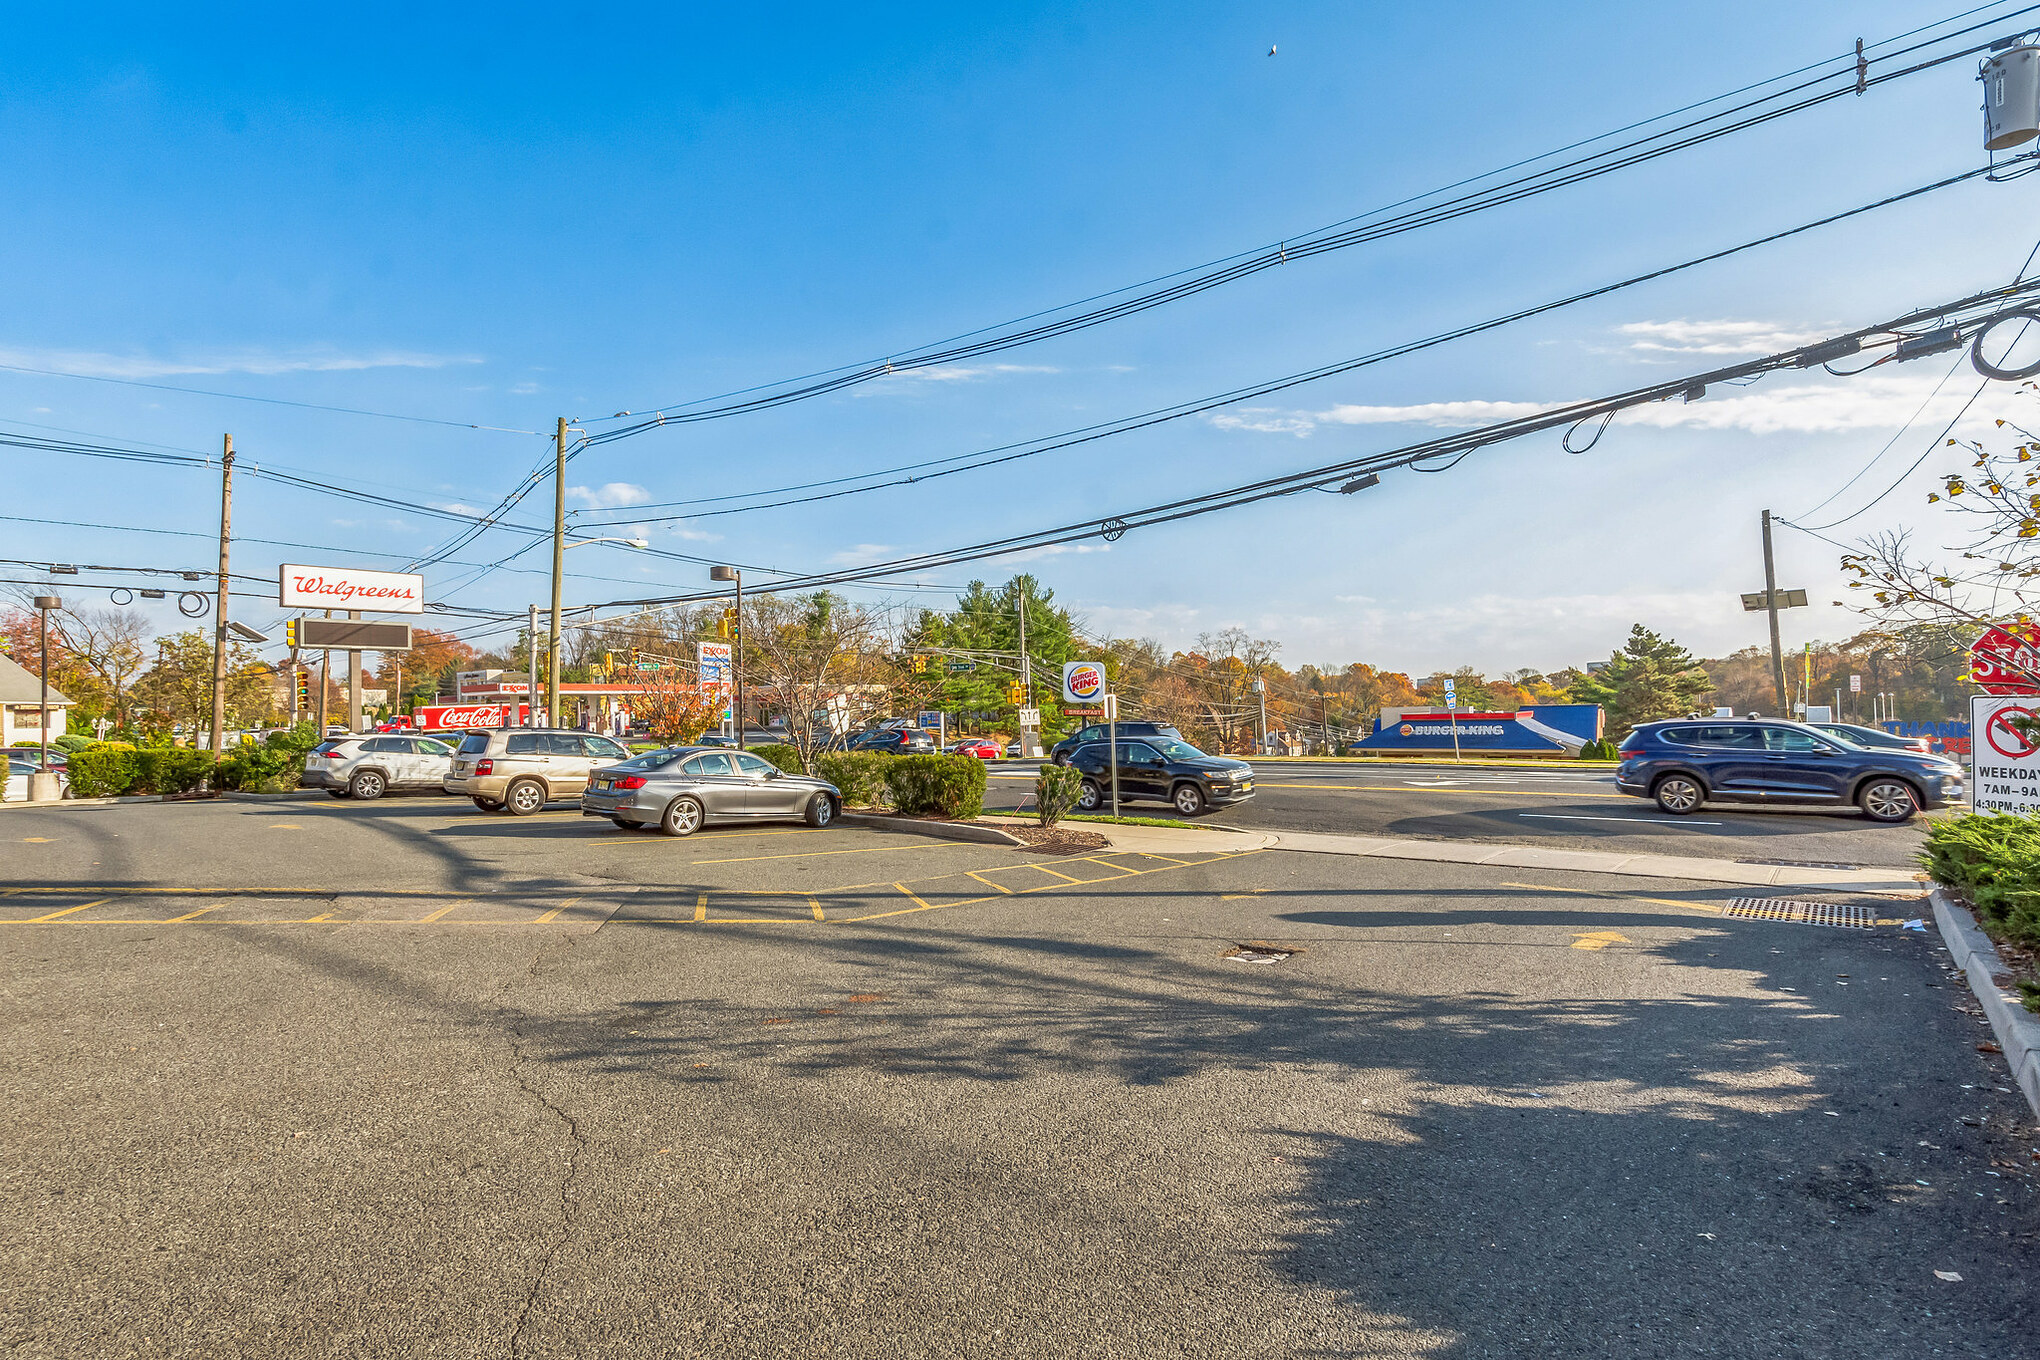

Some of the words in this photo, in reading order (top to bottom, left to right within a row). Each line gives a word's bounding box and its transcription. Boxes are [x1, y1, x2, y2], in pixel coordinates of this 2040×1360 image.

[293, 576, 415, 601] Walgreens
[1071, 671, 1098, 684] BURGER
[1072, 677, 1099, 693] KING
[439, 707, 501, 728] Coca-Cola
[1414, 725, 1466, 736] BURGER
[1467, 725, 1504, 736] KING
